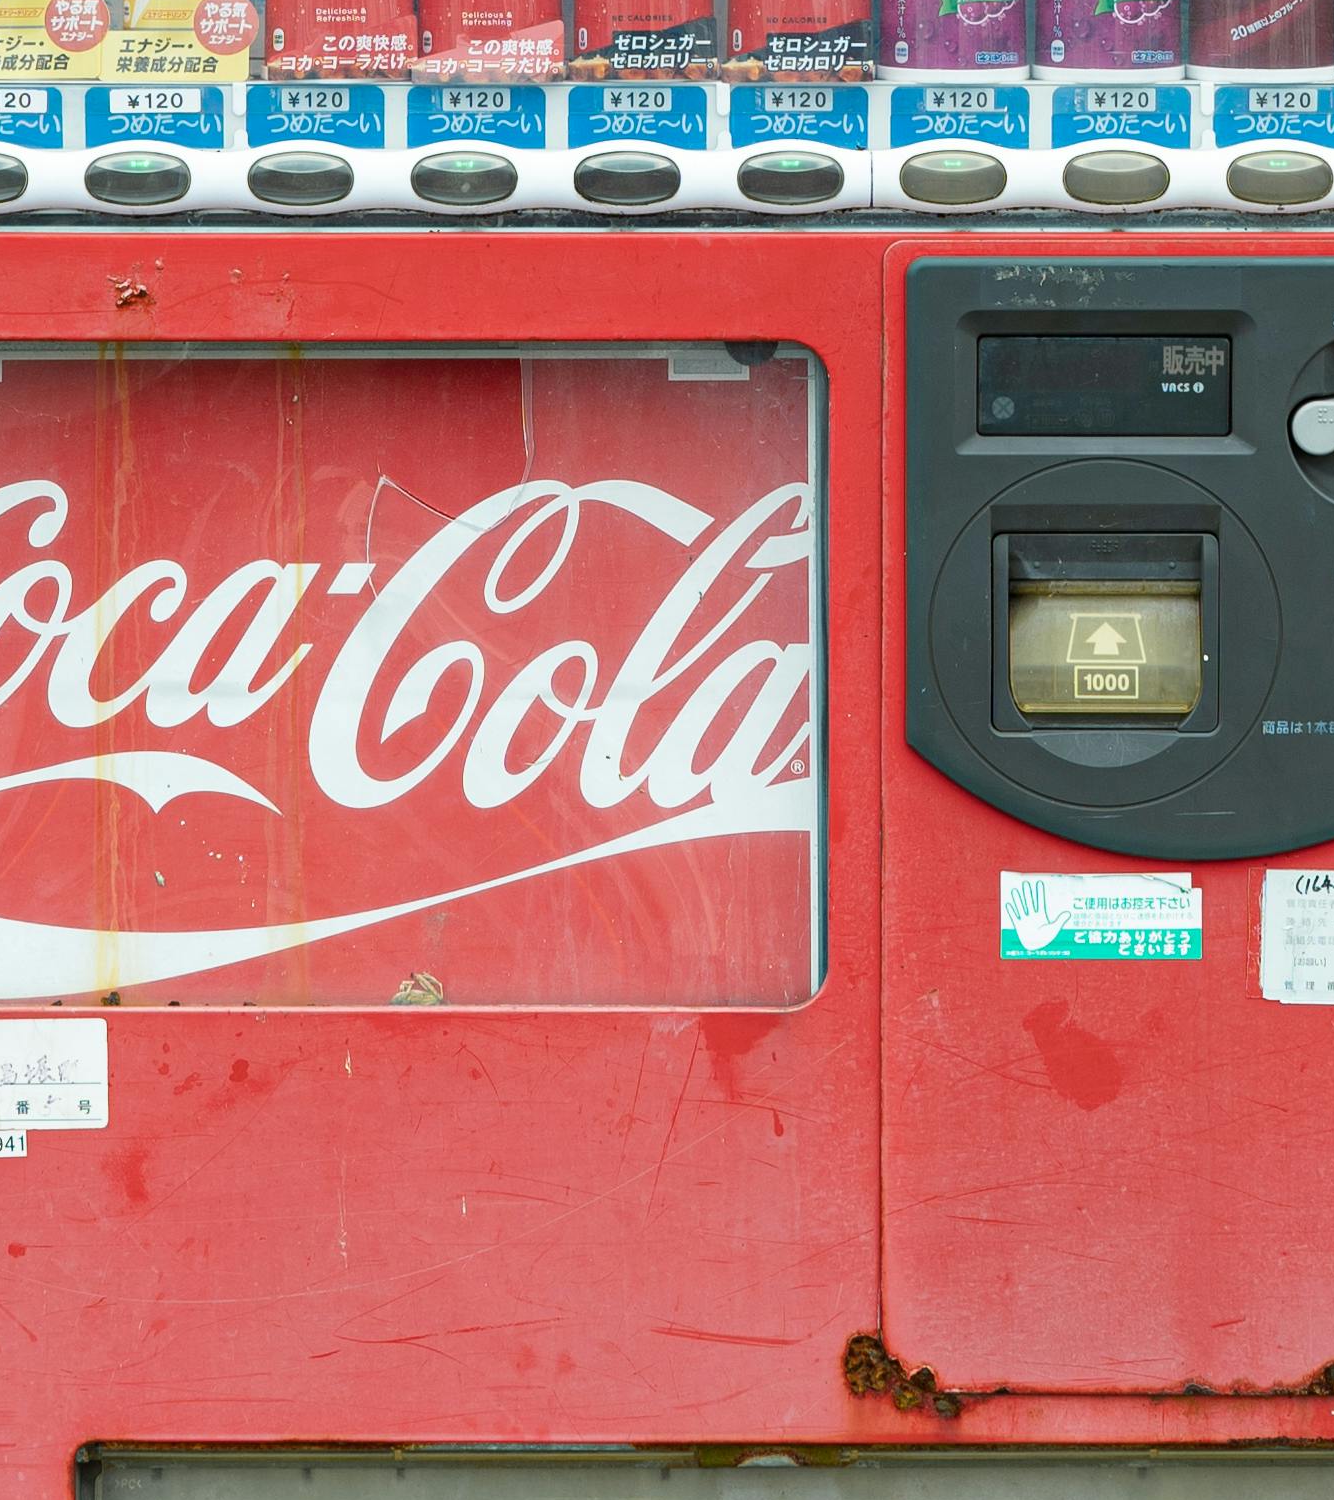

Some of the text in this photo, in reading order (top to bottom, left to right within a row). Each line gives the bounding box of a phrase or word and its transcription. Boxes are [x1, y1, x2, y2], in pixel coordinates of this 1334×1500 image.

[55, 0, 98, 15] やる気
[50, 15, 103, 31] サポート
[60, 32, 93, 42] エナジー
[322, 34, 415, 52] この爽快感。
[615, 34, 710, 52] ゼロシュガー
[281, 53, 418, 72] コカ・コーラだけ。
[610, 53, 715, 72] ゼロカロリー。
[610, 91, 665, 108] ¥120
[933, 91, 988, 108] ¥120
[1163, 346, 1225, 376] 販売中
[1161, 382, 1190, 393] VACS
[1083, 672, 1130, 693] 1000
[1073, 897, 1191, 910] ご使用はお控え下さい
[1074, 931, 1191, 944] ご協力ありがとう
[1118, 944, 1191, 955] ございます
